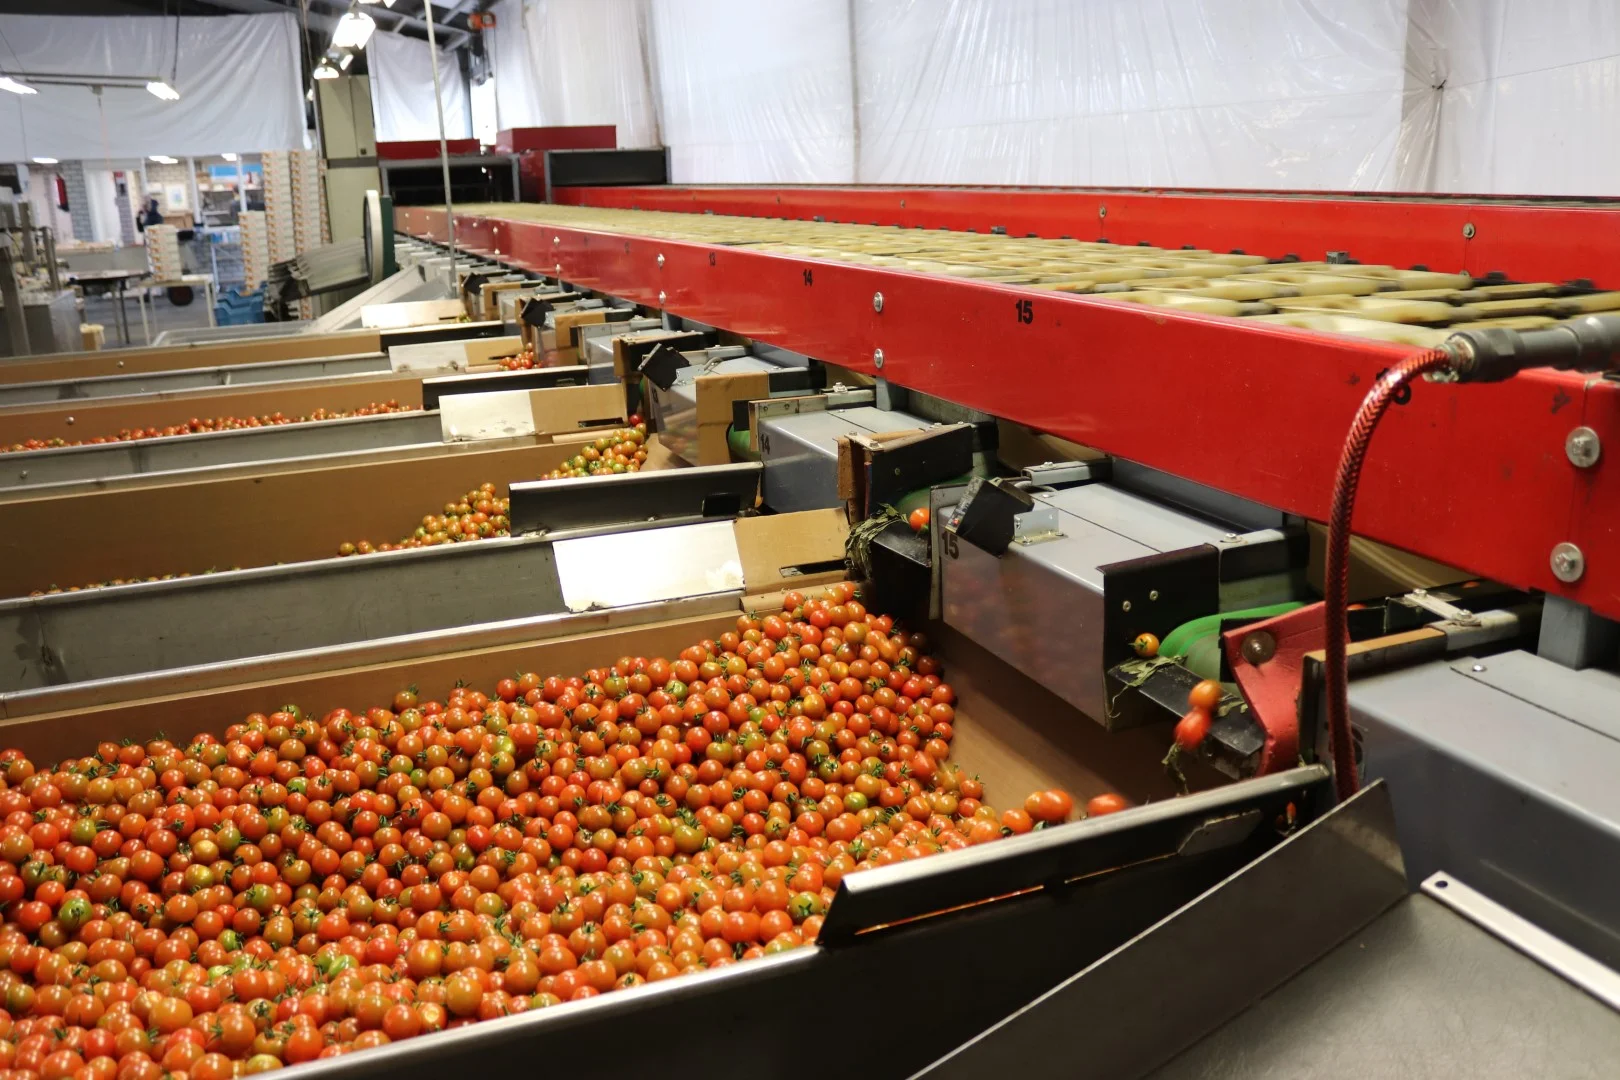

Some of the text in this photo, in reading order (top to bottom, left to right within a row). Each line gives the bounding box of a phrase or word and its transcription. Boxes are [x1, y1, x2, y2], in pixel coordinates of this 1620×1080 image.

[803, 268, 813, 287] 14
[1015, 299, 1034, 325] 15
[760, 433, 771, 455] 14
[941, 530, 960, 560] 15
